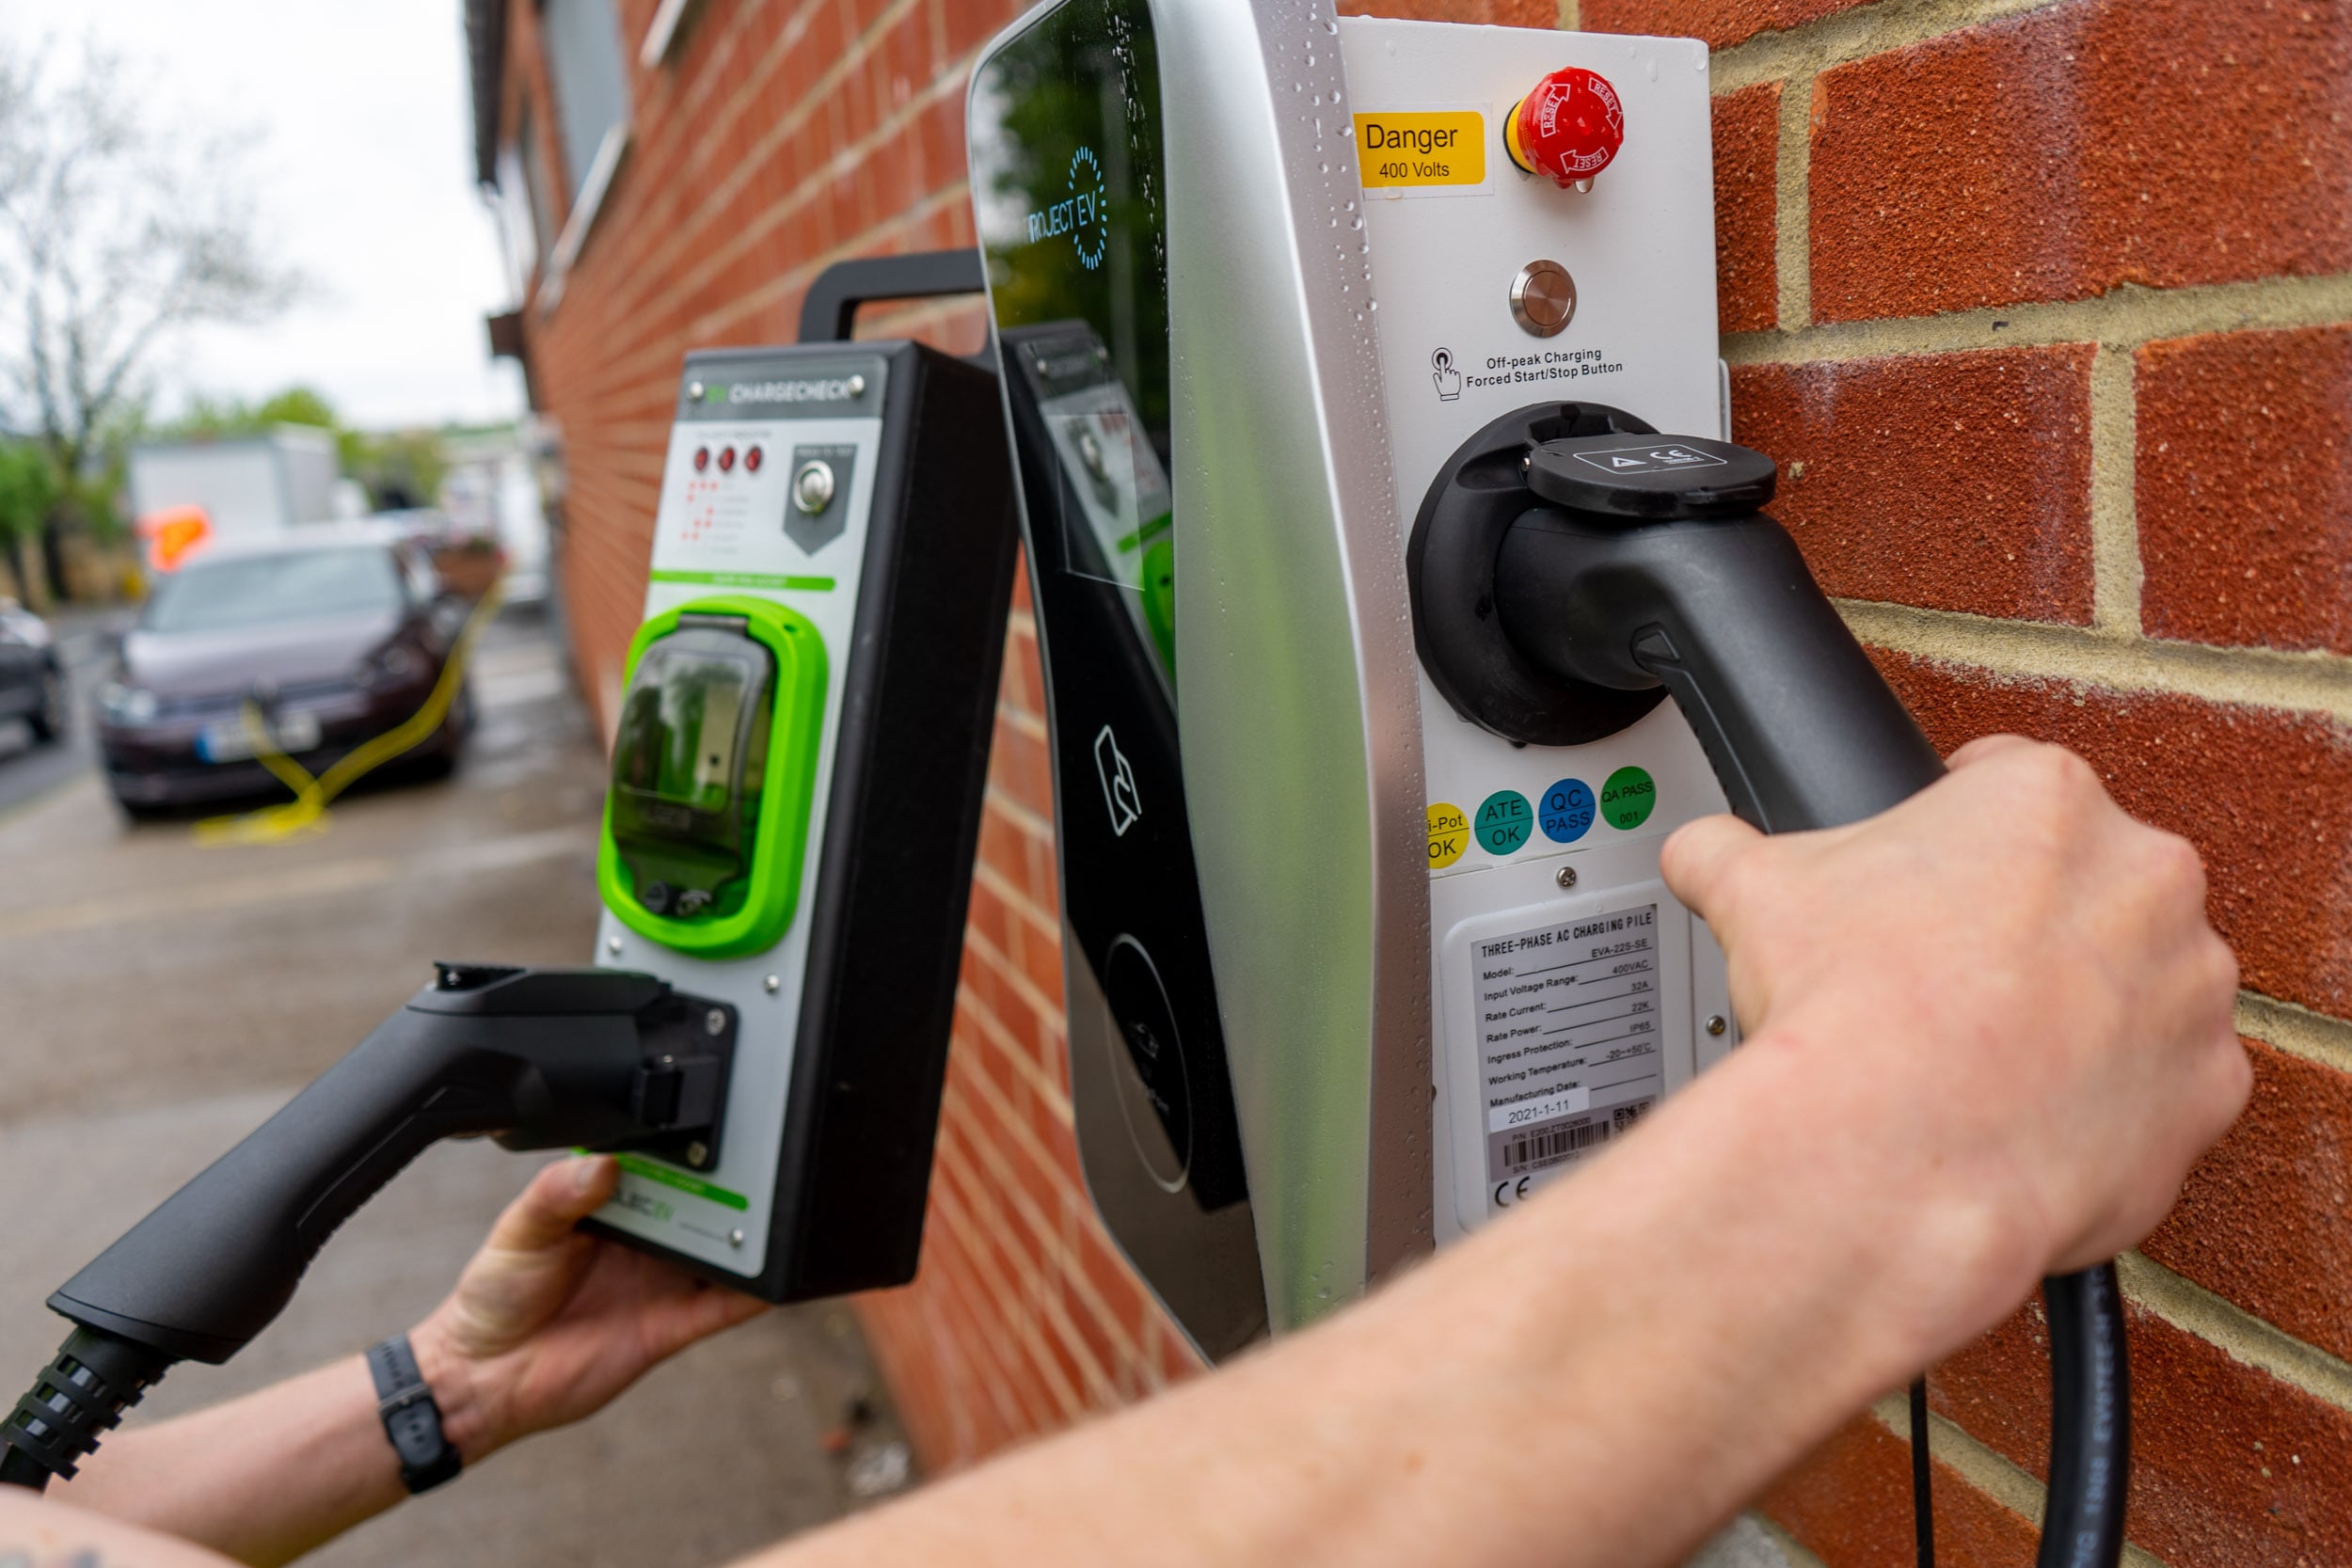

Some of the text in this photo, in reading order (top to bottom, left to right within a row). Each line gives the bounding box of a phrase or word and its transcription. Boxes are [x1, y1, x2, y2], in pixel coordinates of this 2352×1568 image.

[1594, 82, 1617, 114] RESET
[1544, 92, 1561, 128] RESET
[1366, 124, 1458, 154] Danger
[1379, 161, 1450, 178] 400 Volts
[1573, 152, 1603, 168] RESET
[1076, 190, 1096, 226] EV
[1486, 349, 1602, 370] Off-peak Charging
[1467, 363, 1623, 388] Forced Start/Stop Button
[1550, 789, 1581, 811] QC
[1601, 781, 1653, 803] QA PASS
[1485, 799, 1522, 822] ATE
[1619, 812, 1639, 824] 001
[1427, 815, 1463, 832] i-Pot
[1546, 812, 1590, 834] PASS
[1492, 826, 1520, 846] OK
[1428, 838, 1456, 858] OK
[1482, 912, 1652, 958] THREE-PHASE AC CHARGING PILE
[1483, 967, 1515, 980] Model:
[1484, 959, 1648, 1001] Input Voltage Range: 400VAC
[1486, 980, 1648, 1022] Rate Current: 32A
[1486, 1032, 1508, 1043] Rate
[1510, 1025, 1542, 1038] Power:
[1487, 1022, 1650, 1064] Ingress Protection: IP65
[1488, 1070, 1526, 1085] Working
[1528, 1057, 1587, 1076] Temperature:
[1489, 1081, 1581, 1107] Manufacturing Date:
[1508, 1100, 1569, 1124] 2021-1-11
